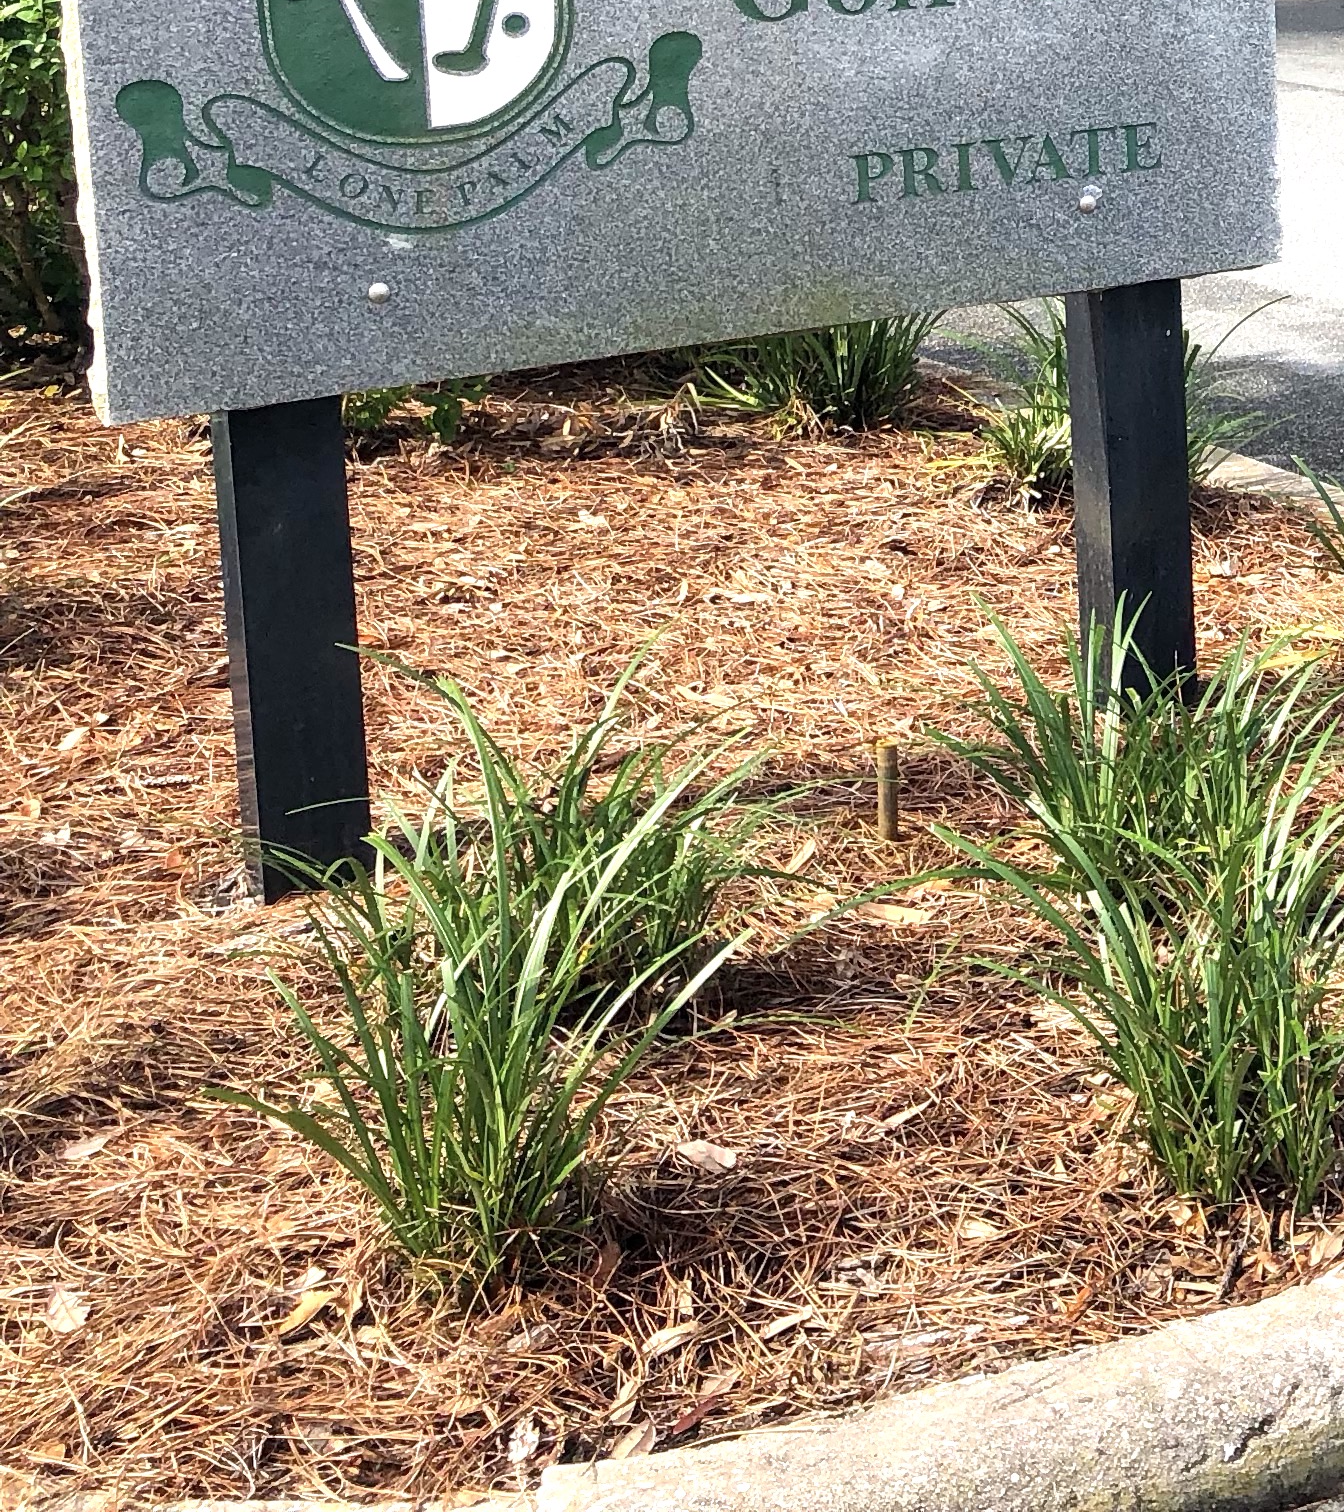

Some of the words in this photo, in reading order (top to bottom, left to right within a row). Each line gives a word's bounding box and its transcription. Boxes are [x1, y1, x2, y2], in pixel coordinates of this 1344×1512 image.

[301, 152, 438, 216] LONE
[458, 111, 575, 208] PALM
[848, 121, 1163, 205] PRIVATE
